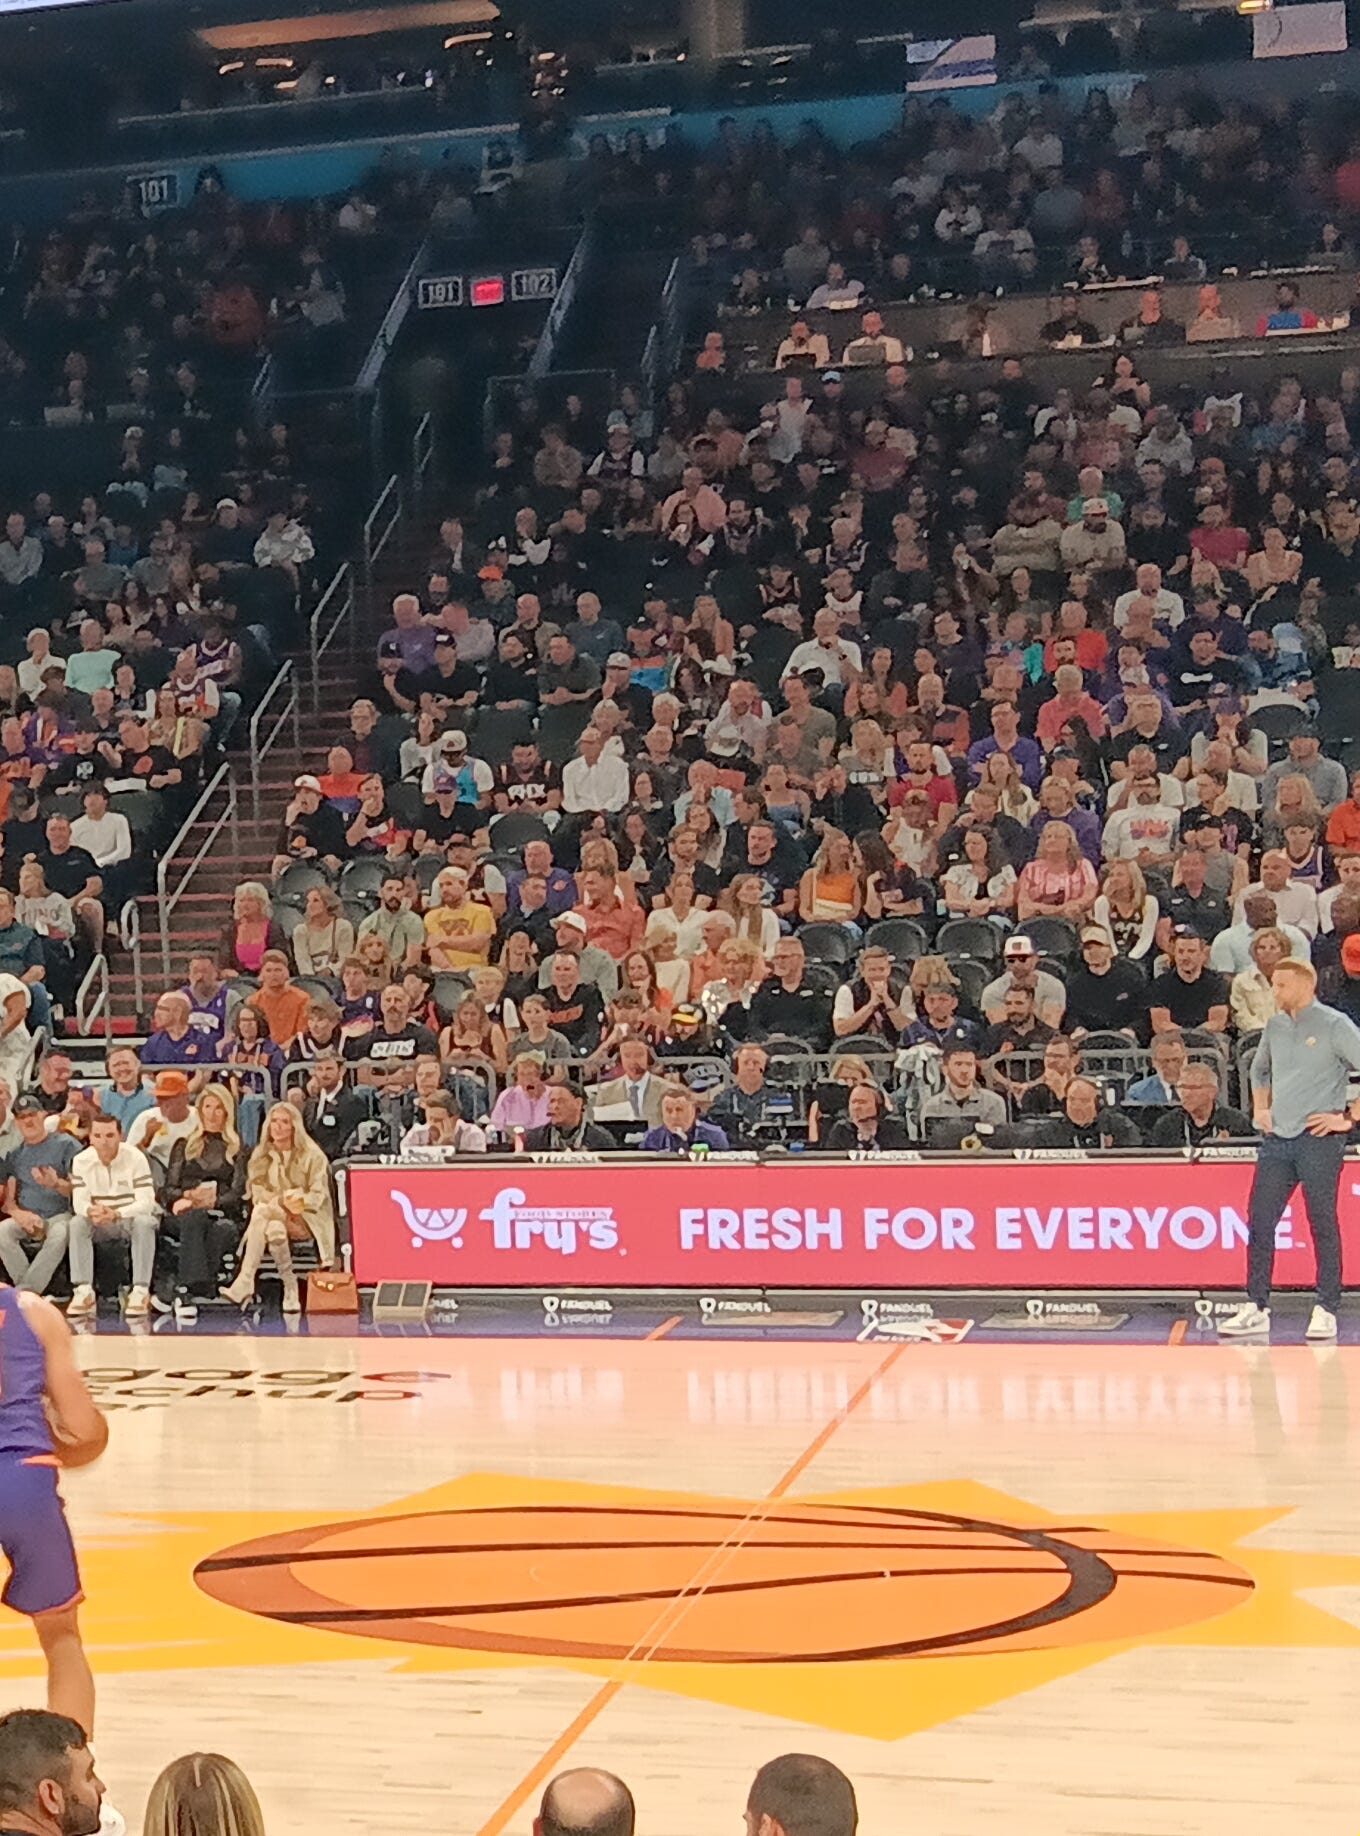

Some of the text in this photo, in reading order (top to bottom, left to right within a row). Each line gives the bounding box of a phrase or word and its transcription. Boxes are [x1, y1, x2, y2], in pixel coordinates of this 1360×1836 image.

[139, 177, 168, 203] 101
[478, 1187, 619, 1255] fry's
[680, 1207, 843, 1250] FRESH
[864, 1206, 976, 1251] FOR
